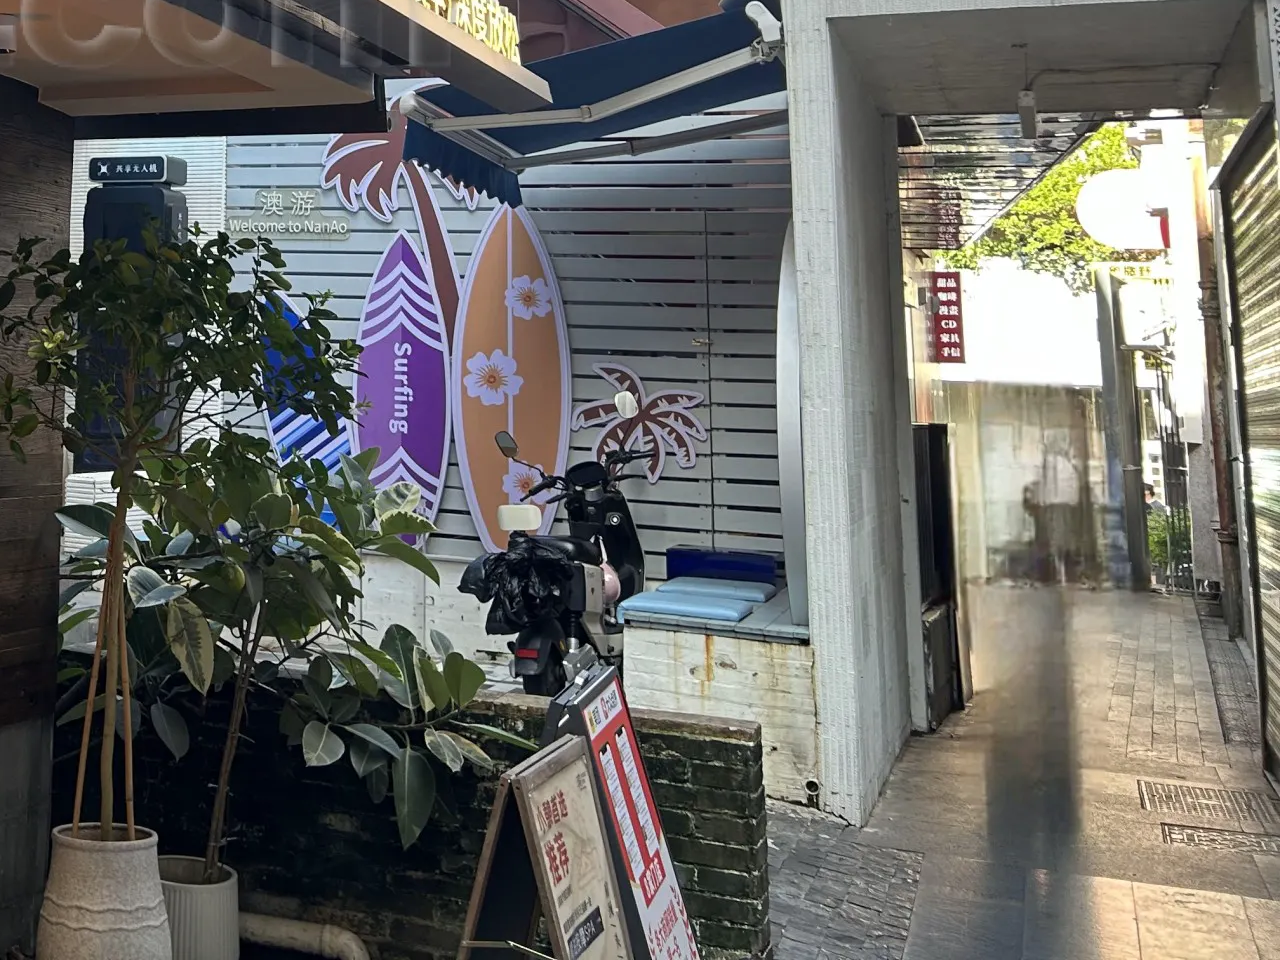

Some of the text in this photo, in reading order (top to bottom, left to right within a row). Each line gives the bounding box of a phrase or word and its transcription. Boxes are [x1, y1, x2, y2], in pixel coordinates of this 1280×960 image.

[260, 190, 315, 216] 澳游
[229, 219, 348, 234] Welcome to NanAo
[940, 319, 958, 329] CD
[388, 341, 414, 435] Surfing
